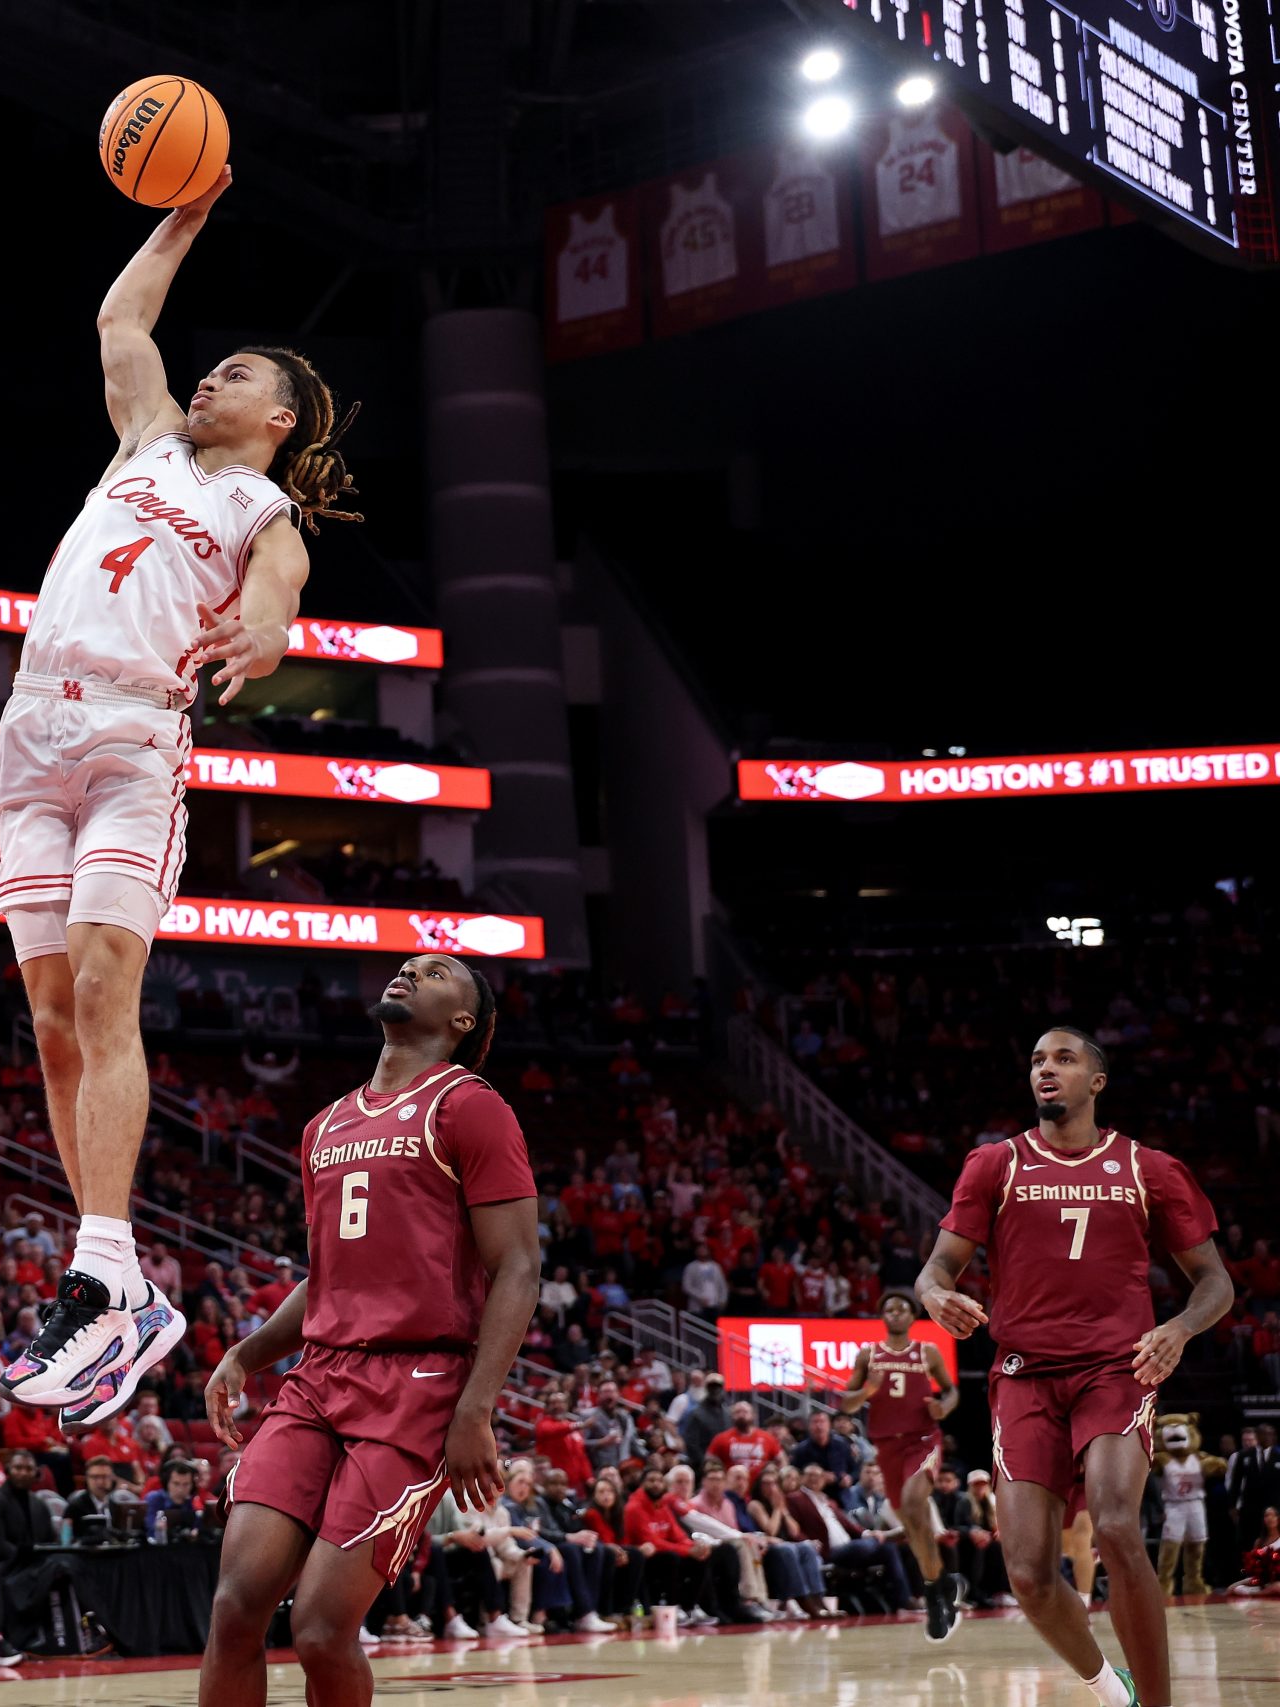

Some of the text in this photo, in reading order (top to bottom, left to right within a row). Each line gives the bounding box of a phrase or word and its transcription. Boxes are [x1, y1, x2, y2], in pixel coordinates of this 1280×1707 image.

[112, 96, 166, 177] Wilson
[1230, 80, 1257, 195] CENTER
[898, 156, 937, 194] 24
[106, 476, 222, 560] Cougars
[99, 536, 155, 594] 4
[194, 754, 277, 787] TEAM
[899, 760, 1085, 795] HOUSTON'S
[1088, 758, 1126, 786] #1
[1129, 752, 1270, 785] TRUSTED
[204, 905, 291, 940] HVAC
[292, 911, 379, 944] TEAM
[311, 1136, 422, 1175] SEMINOLES
[339, 1171, 369, 1240] 6
[1015, 1184, 1137, 1205] SEMINOLES
[1060, 1207, 1091, 1260] 7
[889, 1371, 907, 1398] 3
